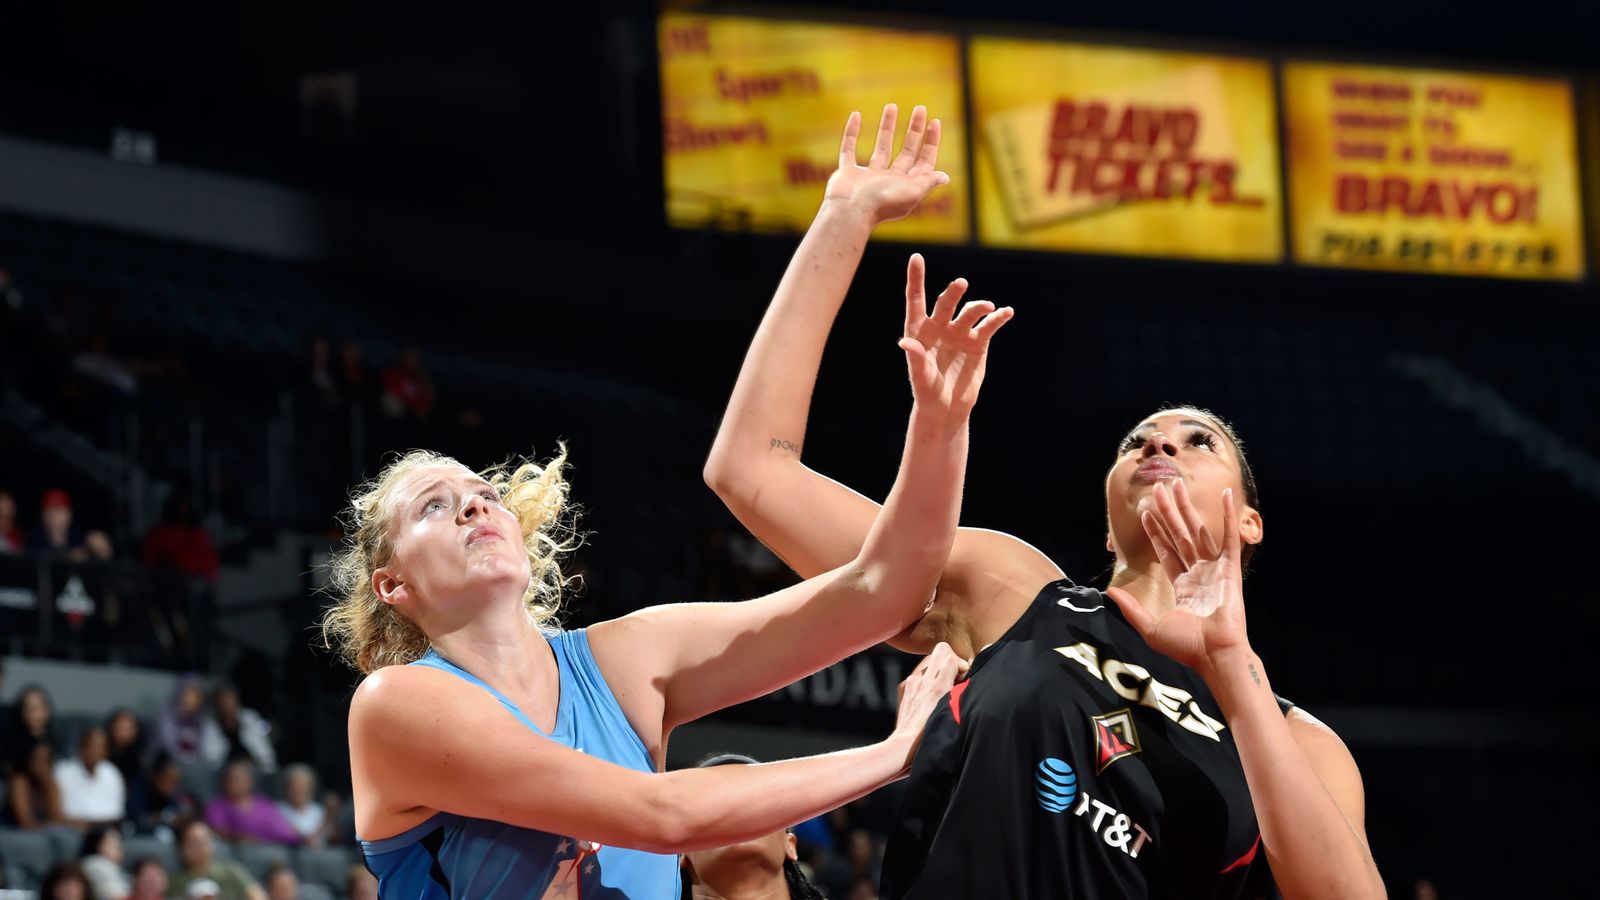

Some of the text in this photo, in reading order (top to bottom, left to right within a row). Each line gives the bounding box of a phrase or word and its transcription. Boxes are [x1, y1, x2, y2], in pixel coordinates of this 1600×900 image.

[1049, 98, 1200, 152] BRAVO
[1335, 172, 1538, 226] BRAVO!
[1053, 643, 1226, 743] ACES
[1073, 791, 1153, 859] AT&T
